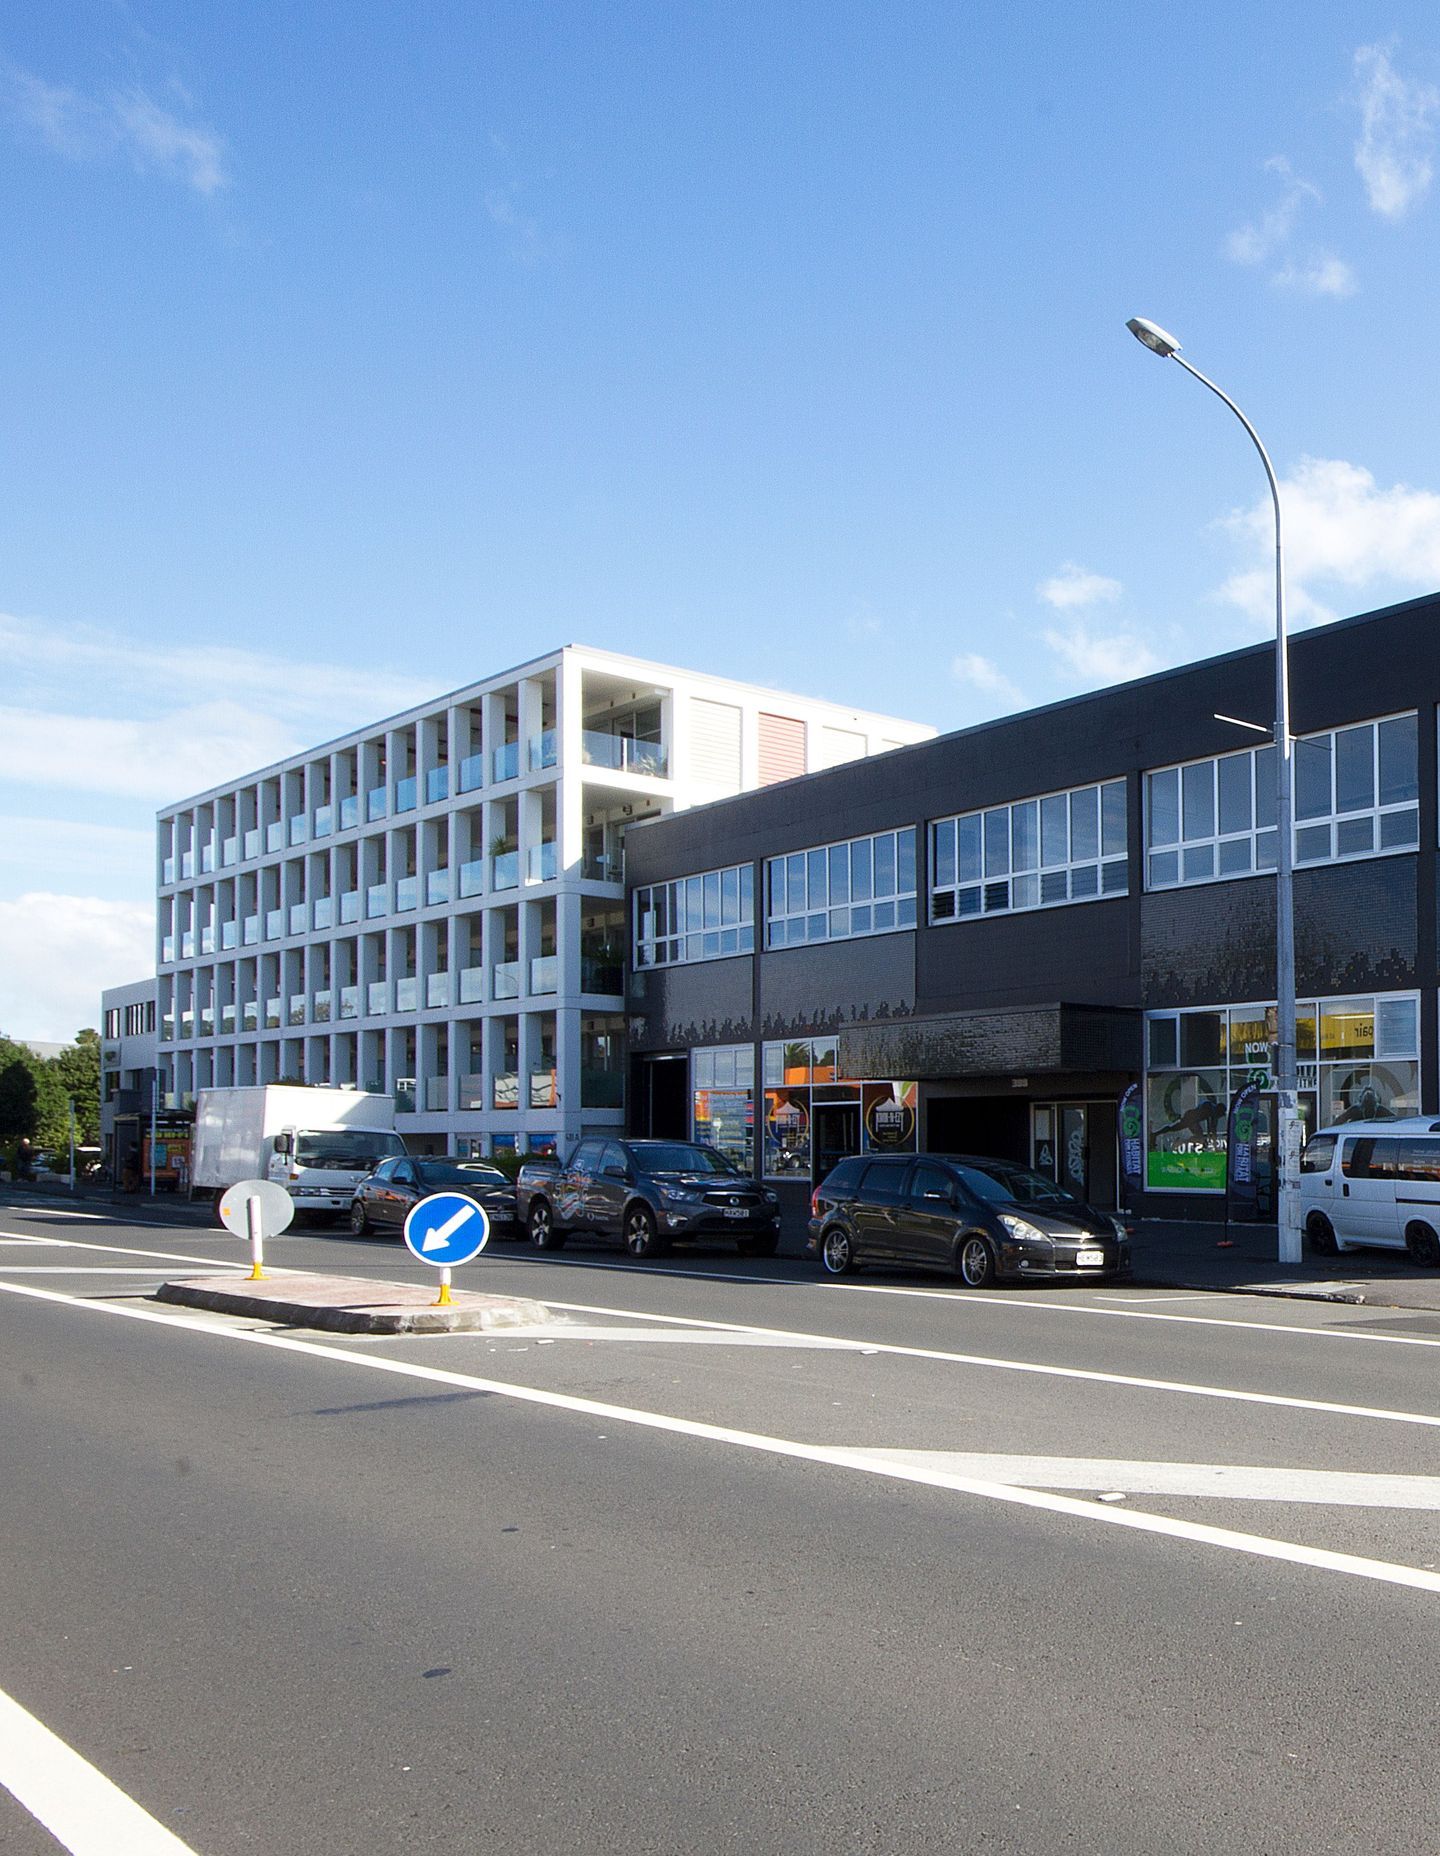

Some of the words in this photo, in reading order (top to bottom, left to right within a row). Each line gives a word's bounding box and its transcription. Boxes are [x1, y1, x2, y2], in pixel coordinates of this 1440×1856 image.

[1244, 1042, 1268, 1054] NOW
[1130, 1138, 1141, 1174] HABITAT
[1237, 1144, 1250, 1182] HABITAT
